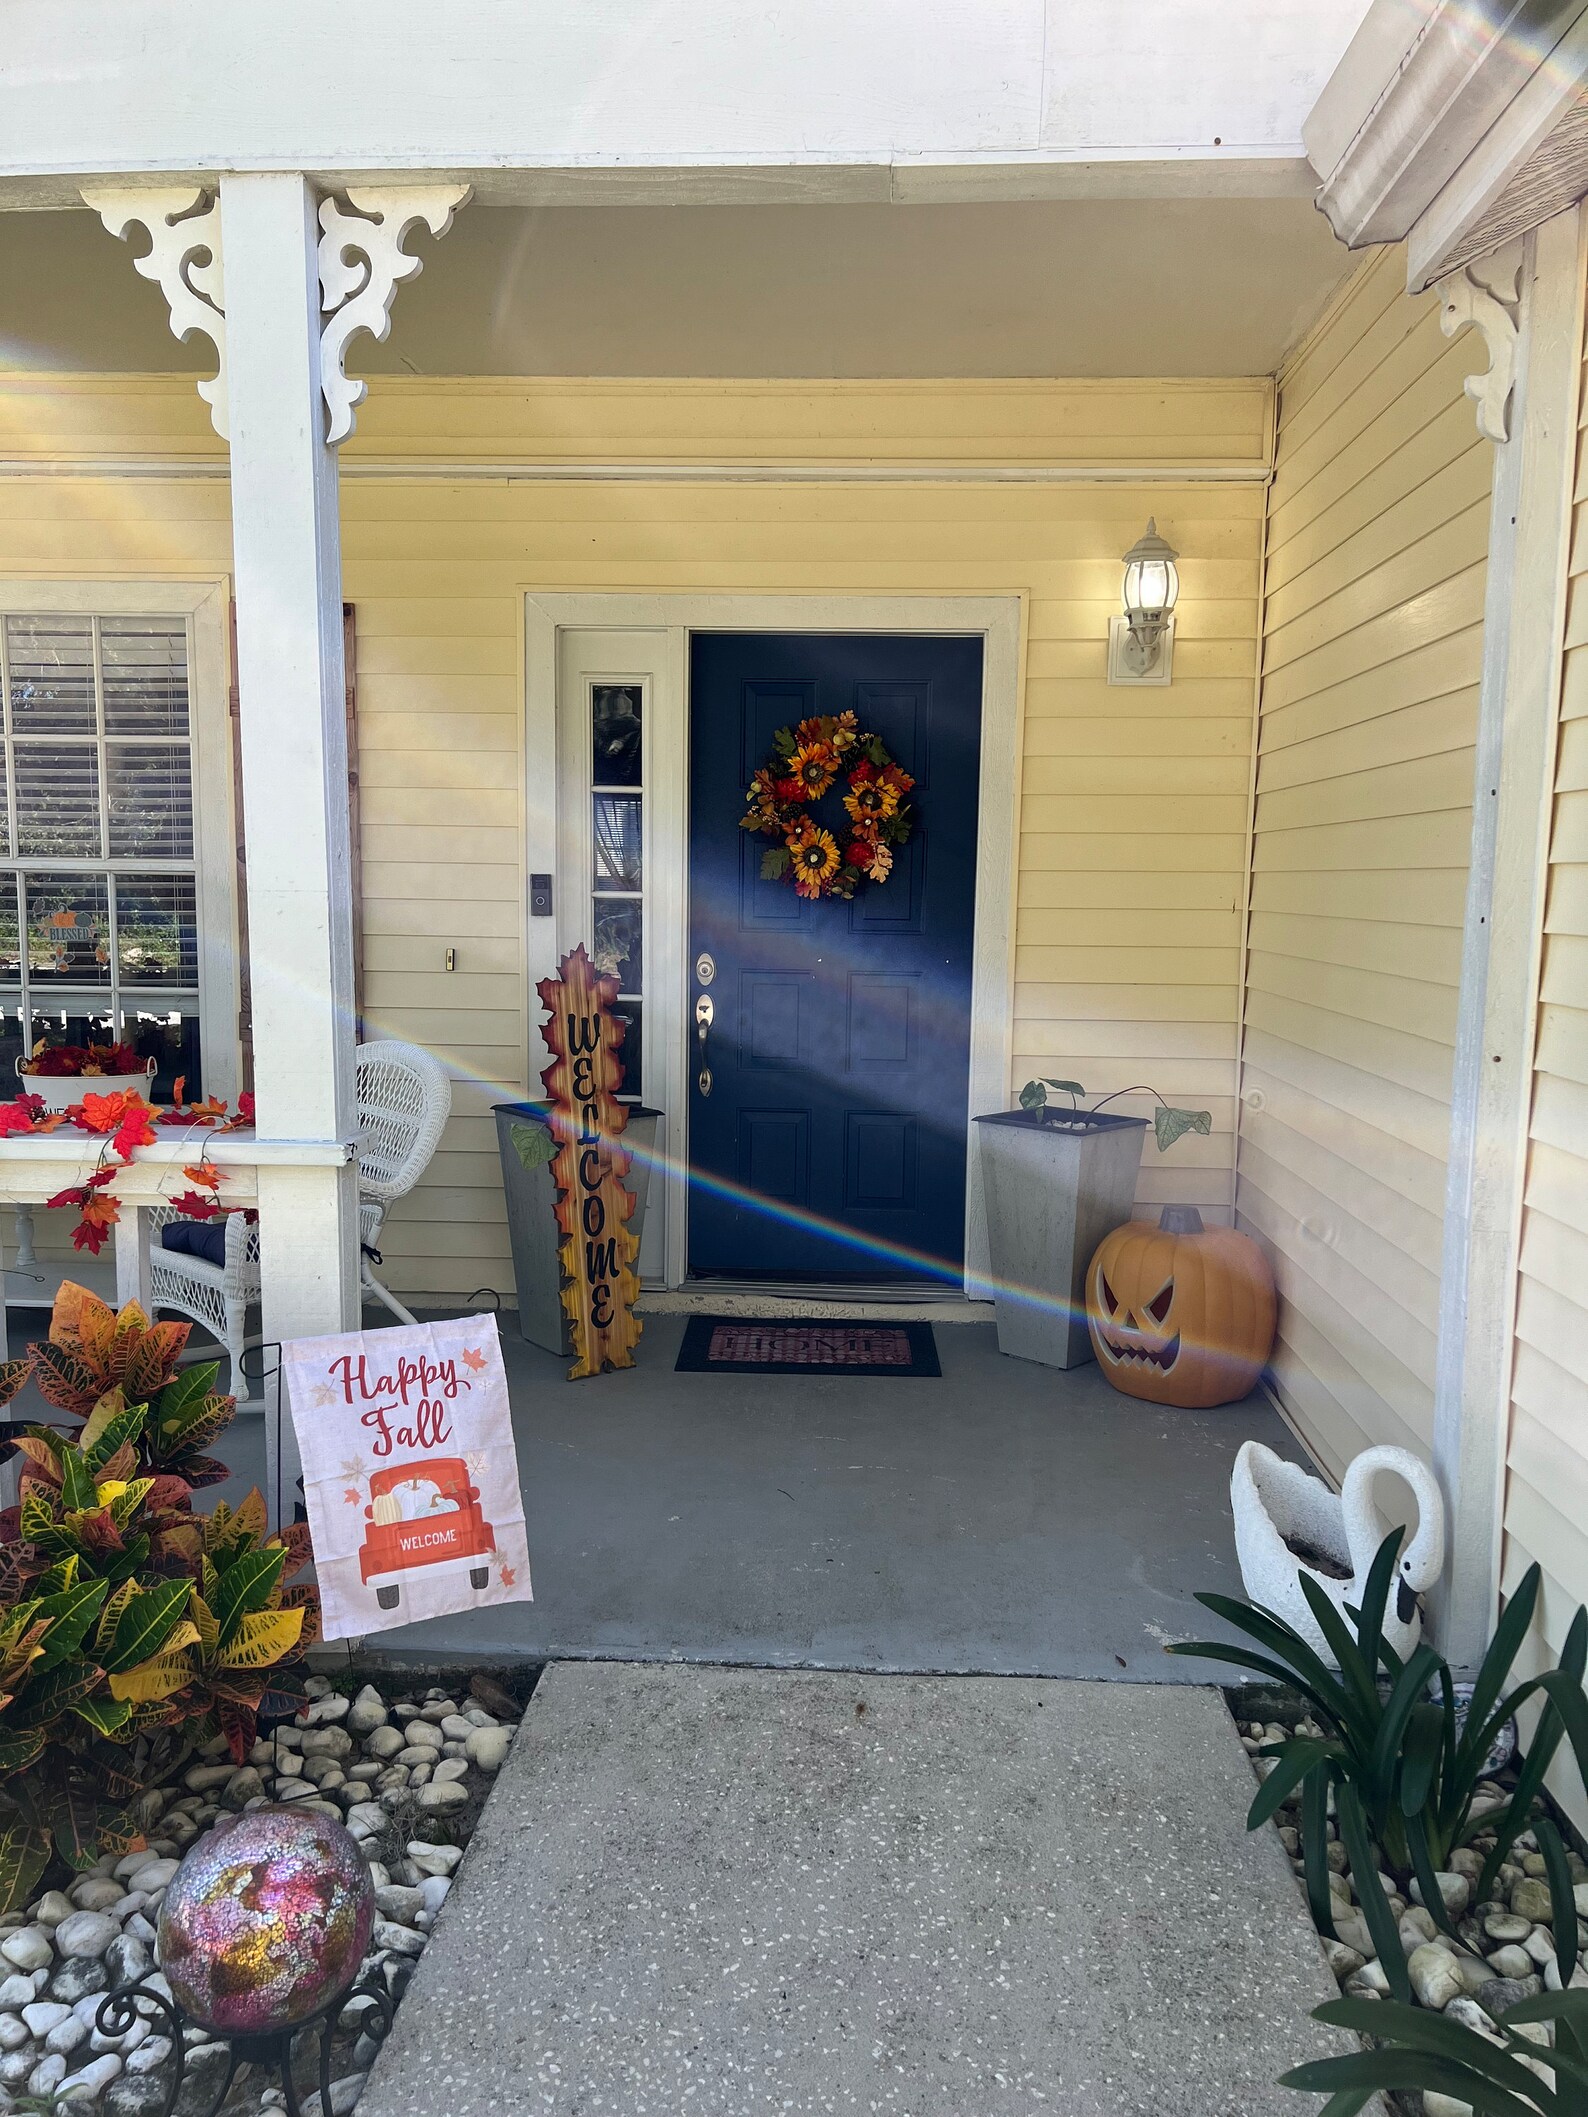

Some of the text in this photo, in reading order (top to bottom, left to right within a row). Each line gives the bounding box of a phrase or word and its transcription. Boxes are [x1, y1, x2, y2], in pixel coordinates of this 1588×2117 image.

[50, 927, 88, 940] BLESSED
[567, 1012, 620, 1330] WELCOME
[328, 1354, 471, 1405] Happy
[360, 1398, 453, 1456] Fall
[400, 1529, 457, 1551] WELCOME
